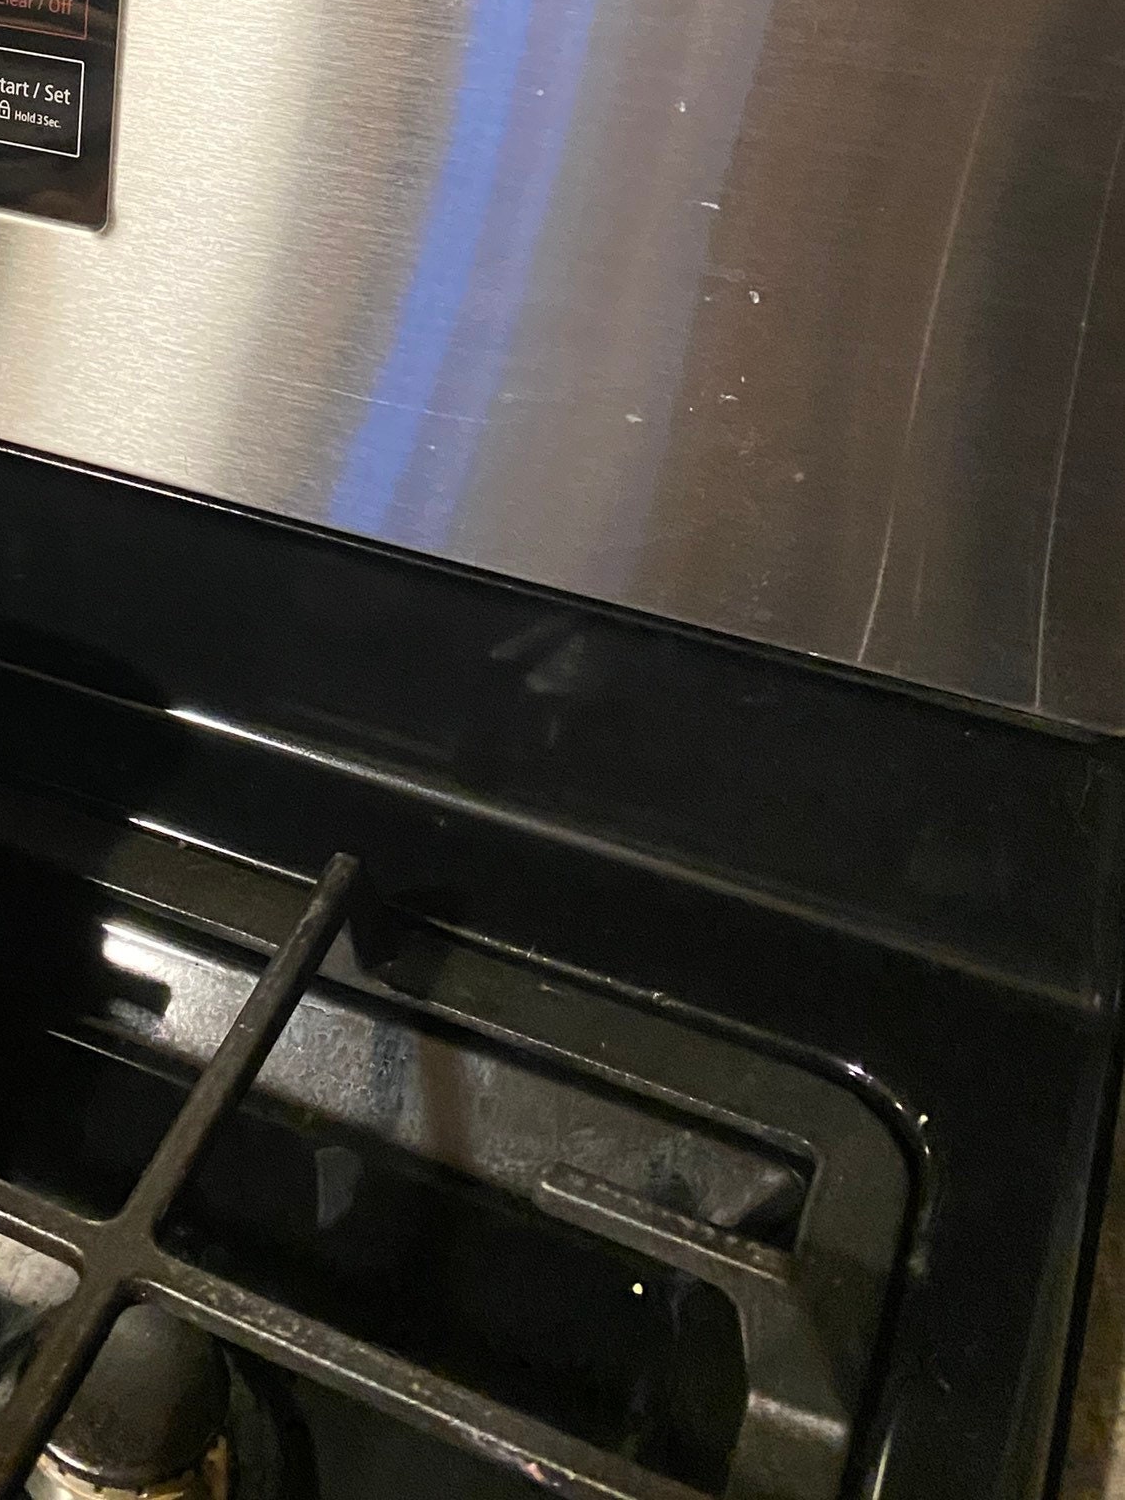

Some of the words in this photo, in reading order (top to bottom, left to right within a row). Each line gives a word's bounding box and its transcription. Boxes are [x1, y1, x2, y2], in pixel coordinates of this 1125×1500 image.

[44, 84, 71, 105] Set
[14, 110, 36, 124] Hold
[37, 114, 43, 125] 3
[43, 115, 62, 129] Sec.
